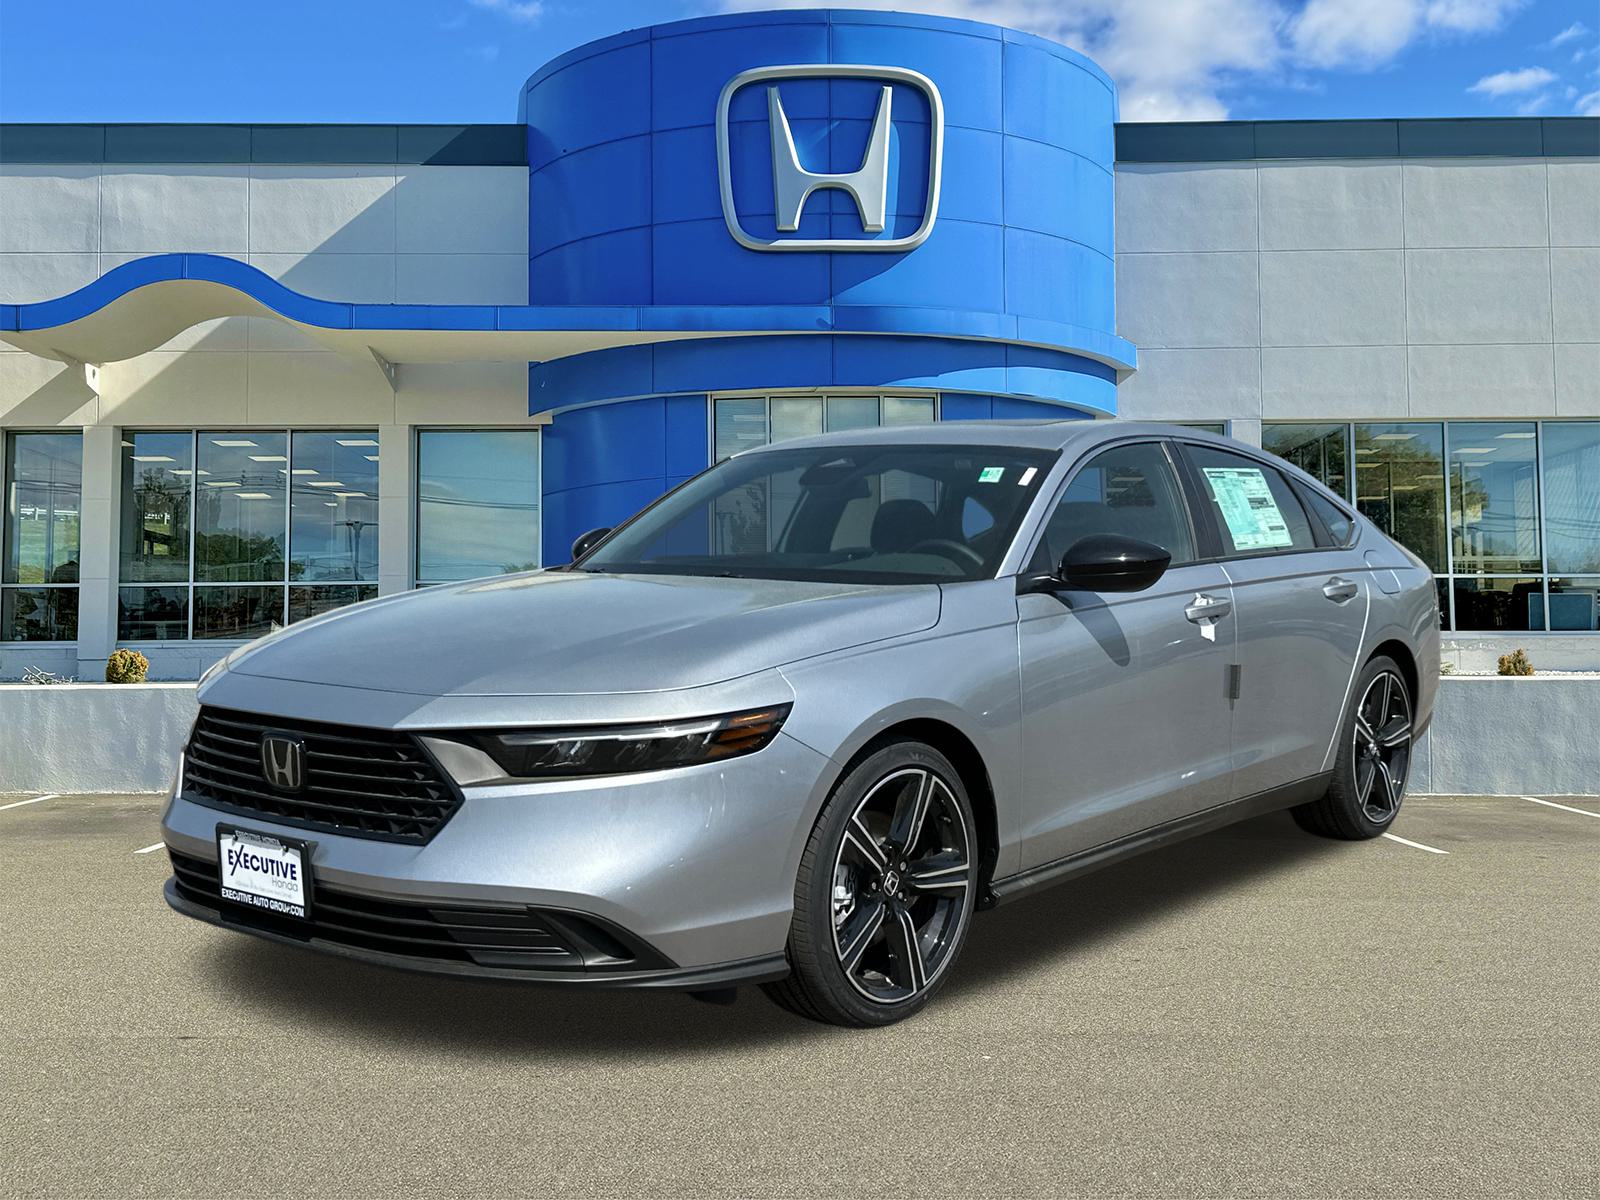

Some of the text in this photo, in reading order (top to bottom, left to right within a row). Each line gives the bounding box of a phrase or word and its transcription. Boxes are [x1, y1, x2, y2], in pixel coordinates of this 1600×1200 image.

[228, 844, 297, 881] EXECUTIVE
[272, 877, 299, 892] Honda
[221, 887, 253, 904] EXECUTIVE
[253, 895, 269, 908] AUTO
